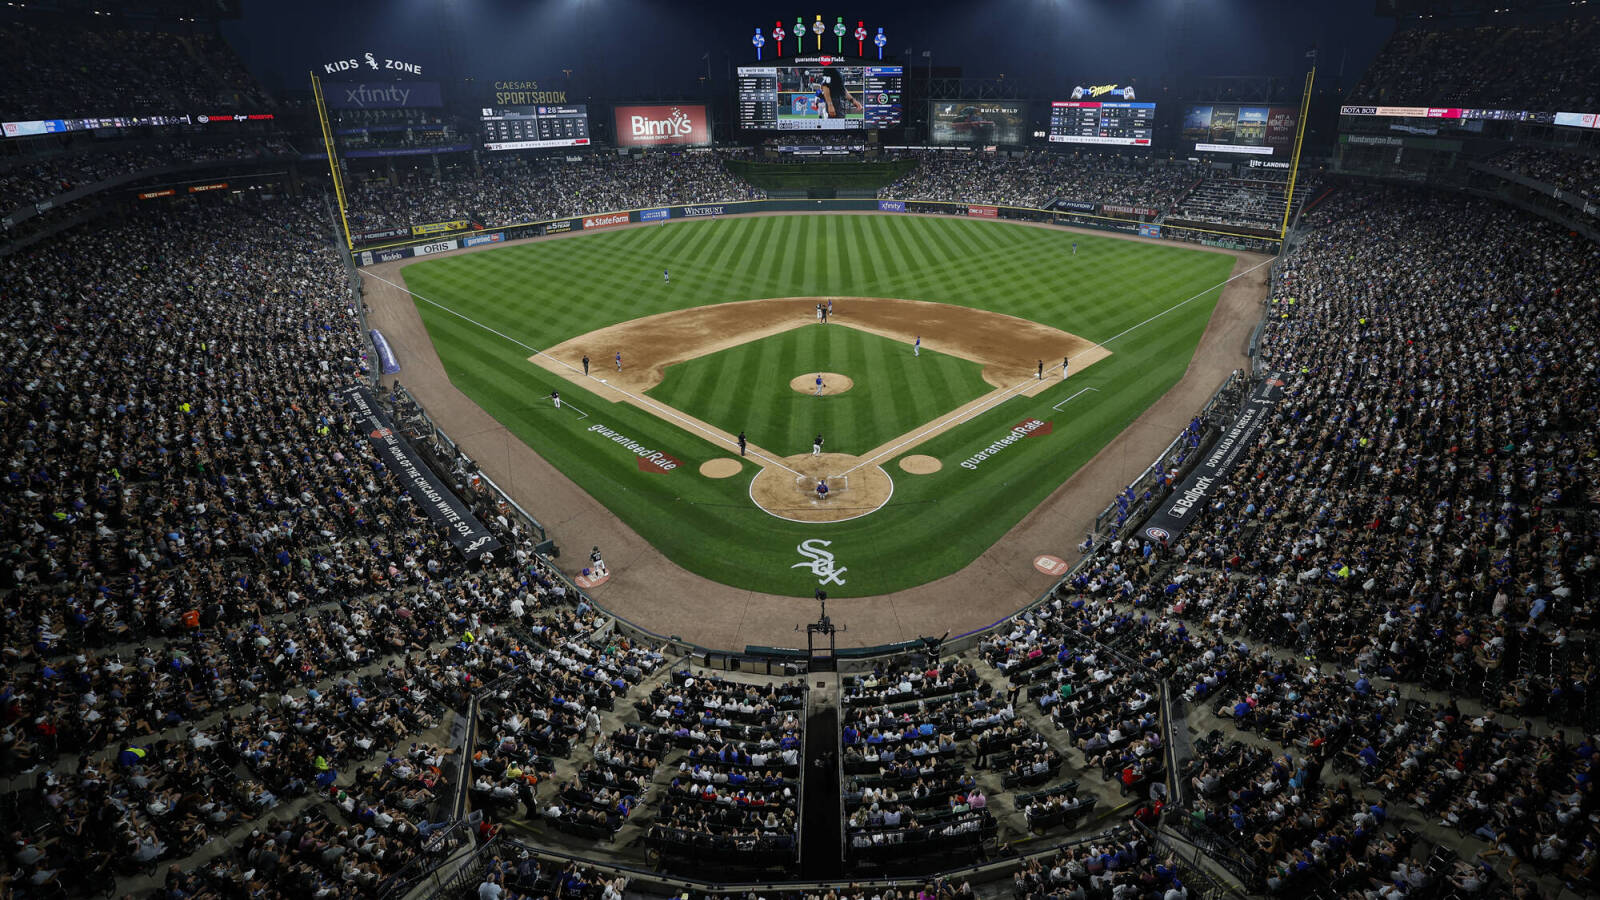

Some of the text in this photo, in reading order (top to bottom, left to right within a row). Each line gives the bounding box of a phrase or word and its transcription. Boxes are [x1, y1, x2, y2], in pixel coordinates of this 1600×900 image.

[324, 58, 359, 74] KIDS
[385, 59, 422, 75] ZONE
[495, 81, 538, 90] CAESARS
[1089, 84, 1118, 98] Miller
[346, 84, 411, 106] xfinity
[496, 91, 567, 105] SPORTSBOOK
[631, 113, 692, 138] Binny's
[1348, 135, 1403, 146] Huntington Bank
[1250, 159, 1290, 169] Lite LANDING
[684, 206, 724, 217] WINTRUST
[881, 201, 901, 210] xfinity
[1066, 201, 1091, 209] HYUNDAI
[424, 242, 449, 253] ORIS
[381, 252, 402, 262] Modelo
[1206, 435, 1235, 468] DOWNLOAD
[1230, 427, 1243, 441] AND
[389, 445, 474, 537] HOME OF THE CHICAGO WHITE SOX
[1178, 476, 1214, 507] Ballpark
[790, 538, 848, 586] Sox
